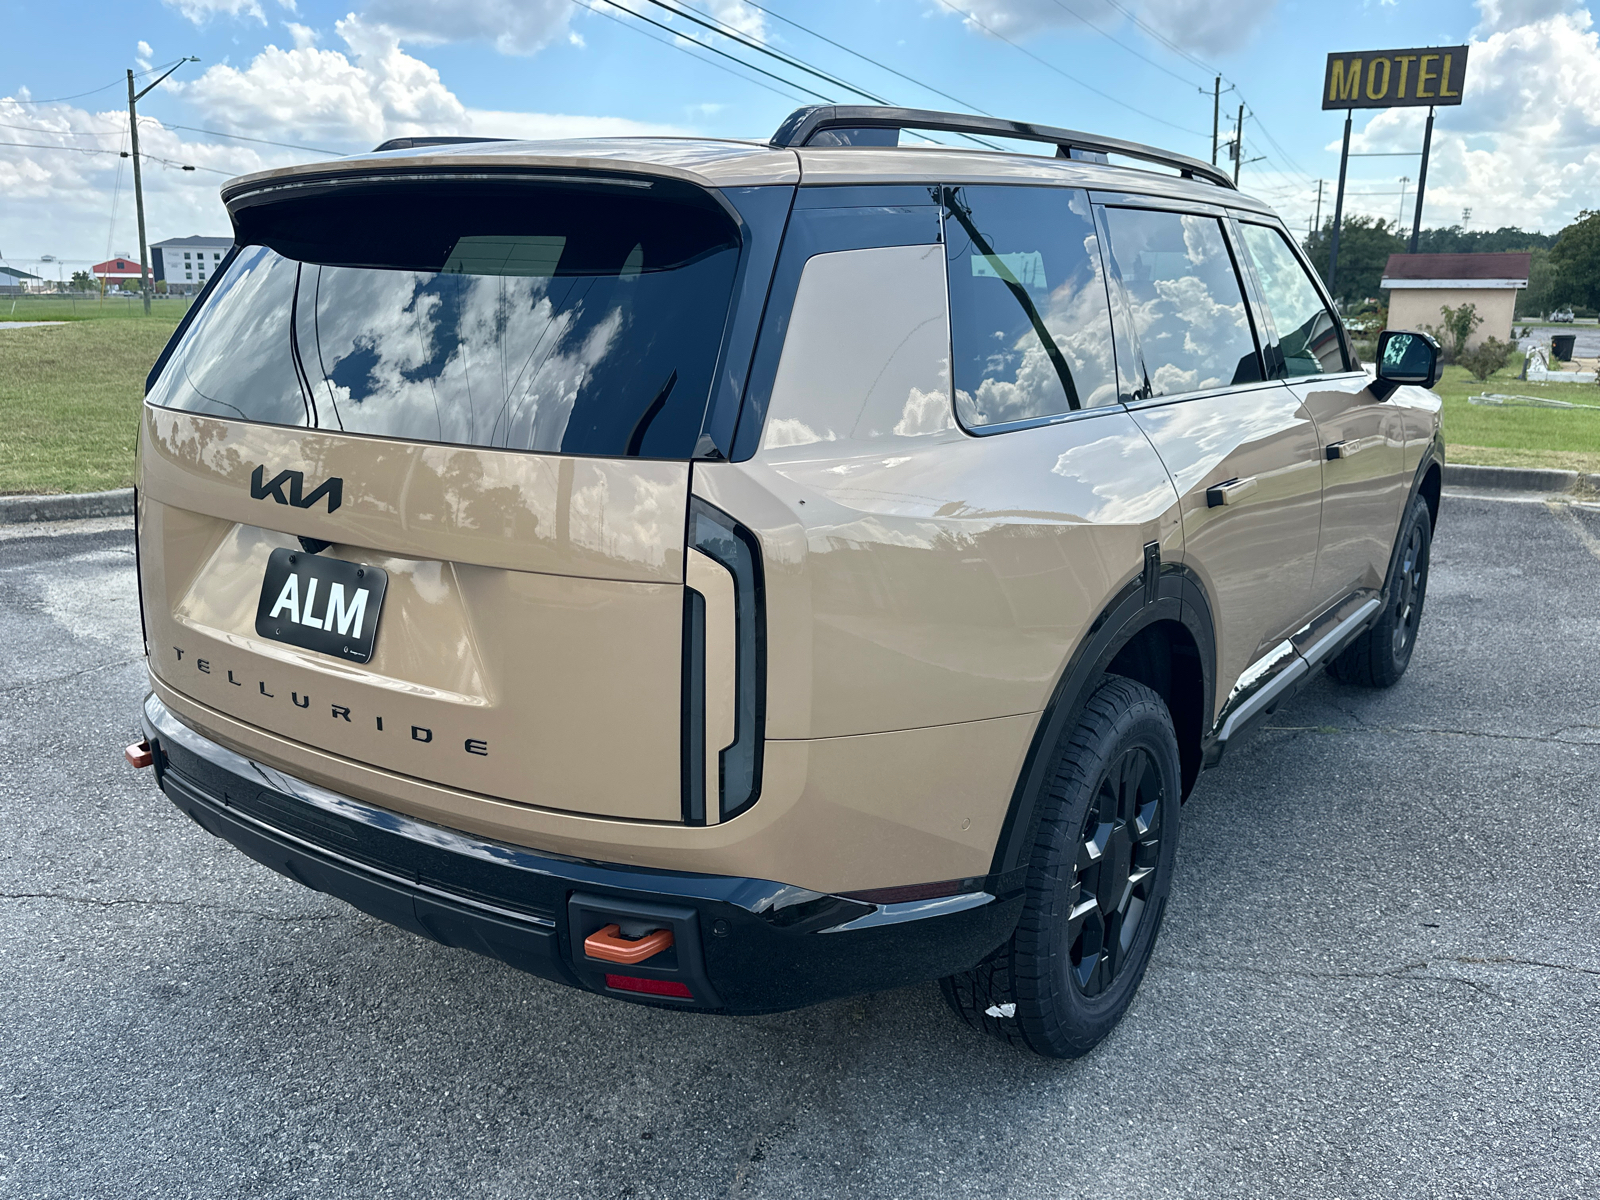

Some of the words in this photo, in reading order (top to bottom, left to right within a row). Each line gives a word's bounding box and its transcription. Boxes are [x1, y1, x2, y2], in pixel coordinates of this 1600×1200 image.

[1329, 54, 1458, 101] MOTEL
[250, 464, 343, 514] KIA
[269, 573, 370, 639] ALM
[173, 646, 489, 757] TELLURIDE
